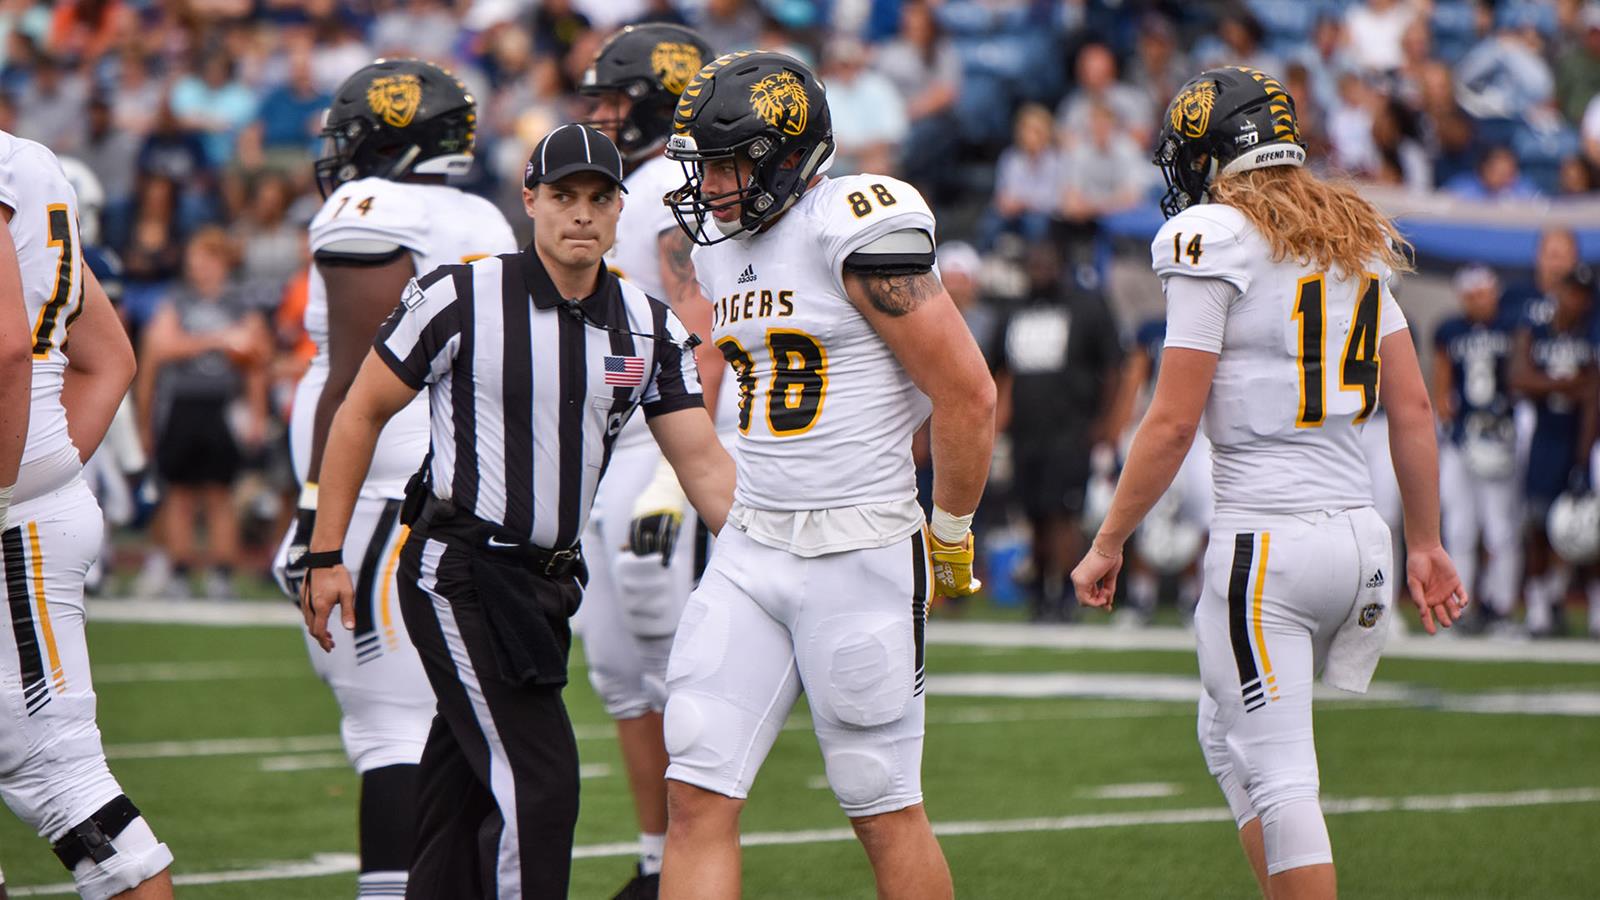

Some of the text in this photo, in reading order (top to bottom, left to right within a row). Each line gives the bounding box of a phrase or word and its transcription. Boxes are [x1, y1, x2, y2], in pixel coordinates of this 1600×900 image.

[1255, 150, 1285, 164] DEFEND
[1286, 150, 1296, 160] THE
[332, 195, 376, 217] 74
[846, 182, 897, 220] 88
[1173, 231, 1204, 266] 14
[711, 289, 796, 333] TIGERS
[1291, 271, 1382, 428] 14
